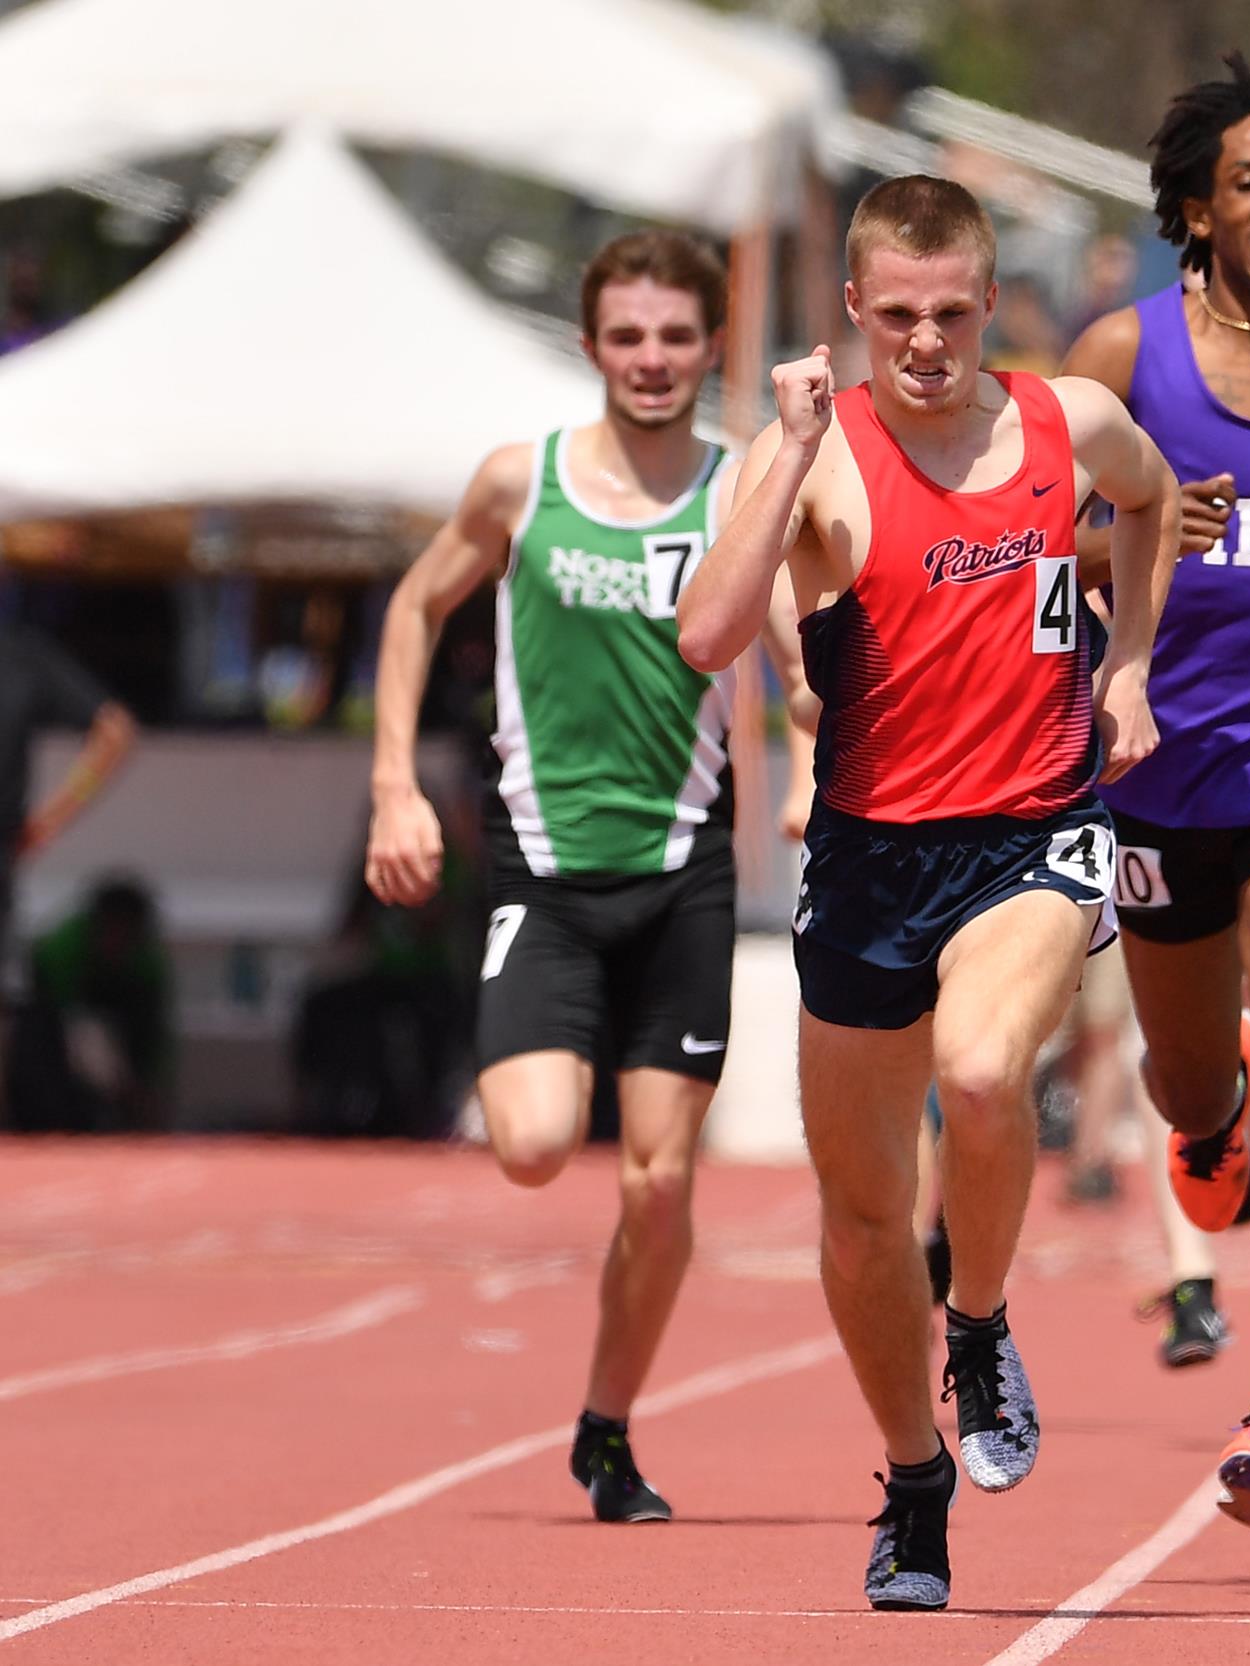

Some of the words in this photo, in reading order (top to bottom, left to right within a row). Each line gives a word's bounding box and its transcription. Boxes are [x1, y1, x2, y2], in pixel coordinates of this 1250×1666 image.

[654, 542, 692, 607] 7
[922, 527, 1048, 593] Patriots
[1039, 562, 1073, 646] 4
[1056, 826, 1102, 881] 4
